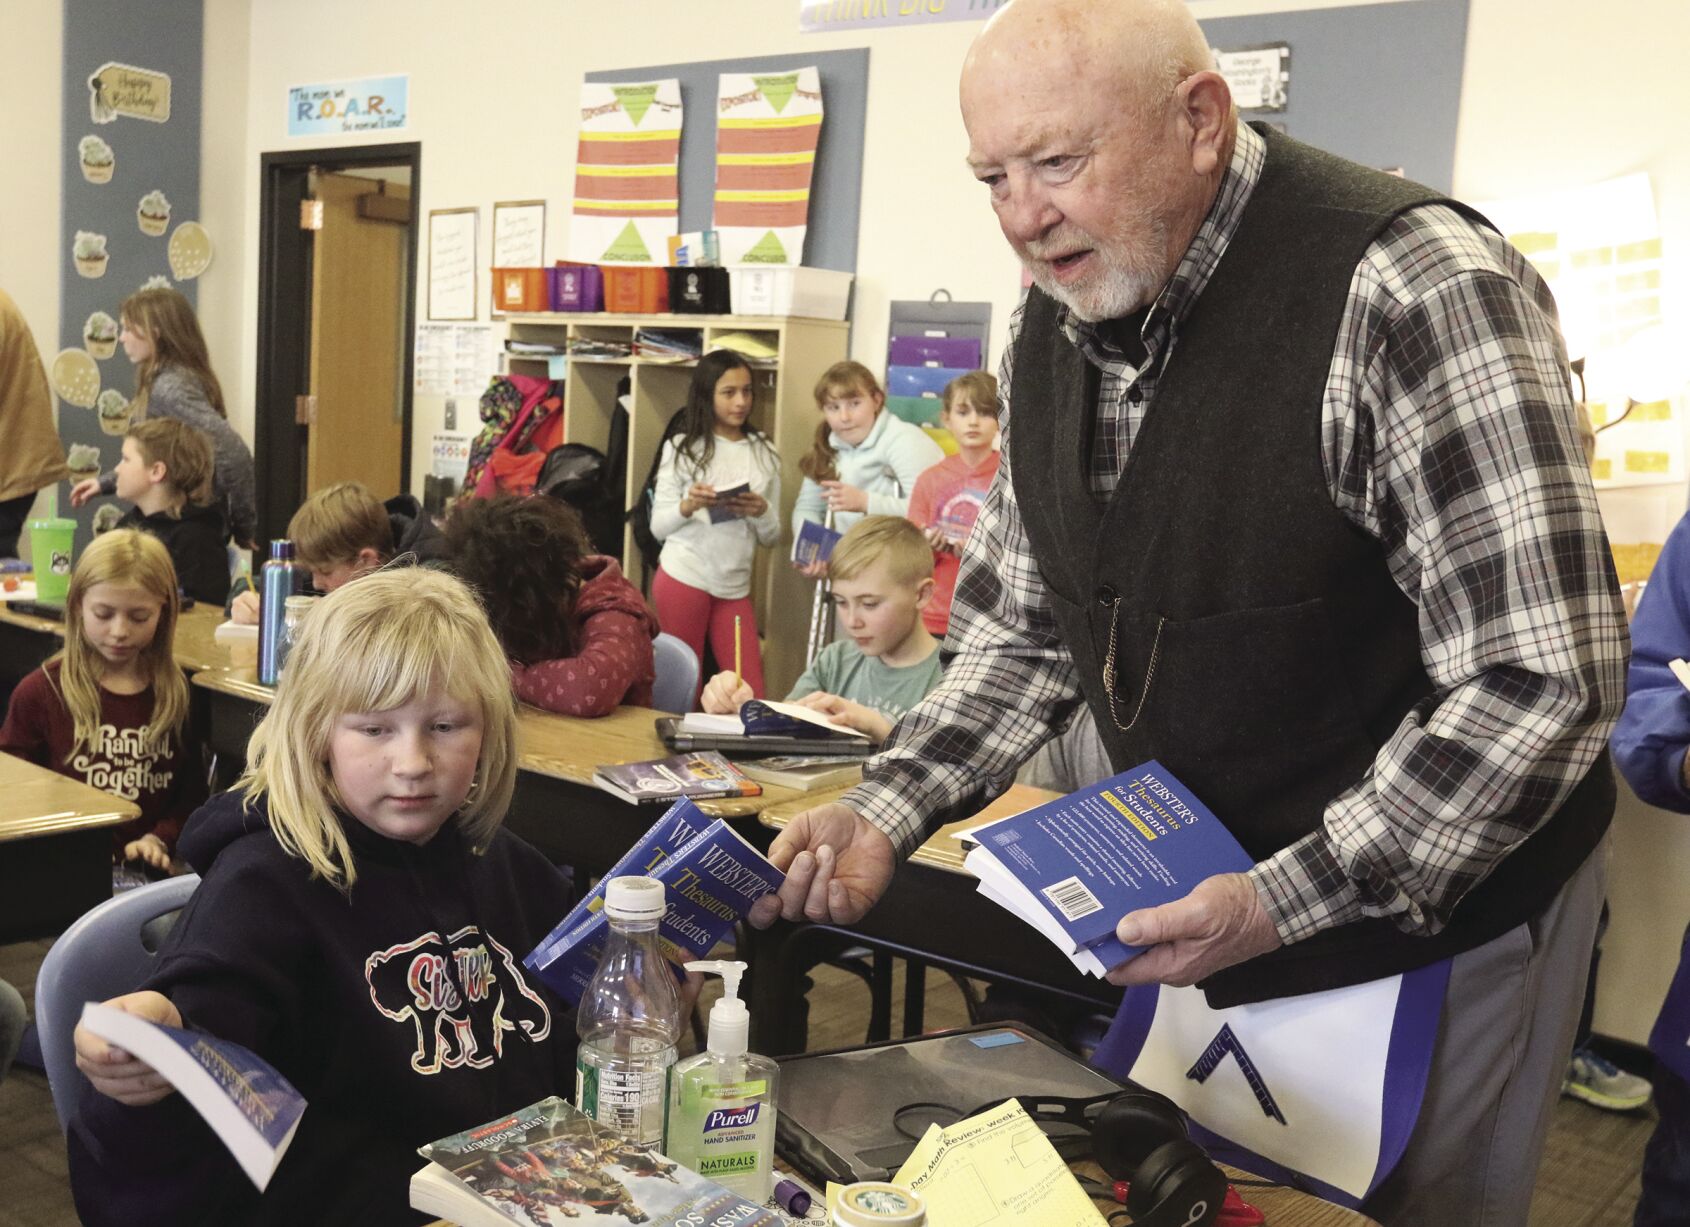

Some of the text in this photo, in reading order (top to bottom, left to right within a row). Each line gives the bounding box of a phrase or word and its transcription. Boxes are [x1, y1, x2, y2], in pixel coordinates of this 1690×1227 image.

[74, 756, 173, 800] Together
[1114, 785, 1168, 835] for Students
[1127, 779, 1181, 830] Thesaurus
[1139, 773, 1199, 824] WEBSTER'S
[673, 828, 709, 859] WEBSTER'S
[586, 871, 612, 898] Students
[671, 867, 738, 922] Thesaurus
[624, 1091, 640, 1103] 190
[514, 1115, 549, 1132] ELVIRA
[711, 1108, 755, 1128] Purell
[704, 1134, 756, 1144] HAND SANITIZER
[928, 1147, 945, 1172] Math
[986, 1113, 1015, 1128] Week
[701, 1155, 755, 1170] NATURALS
